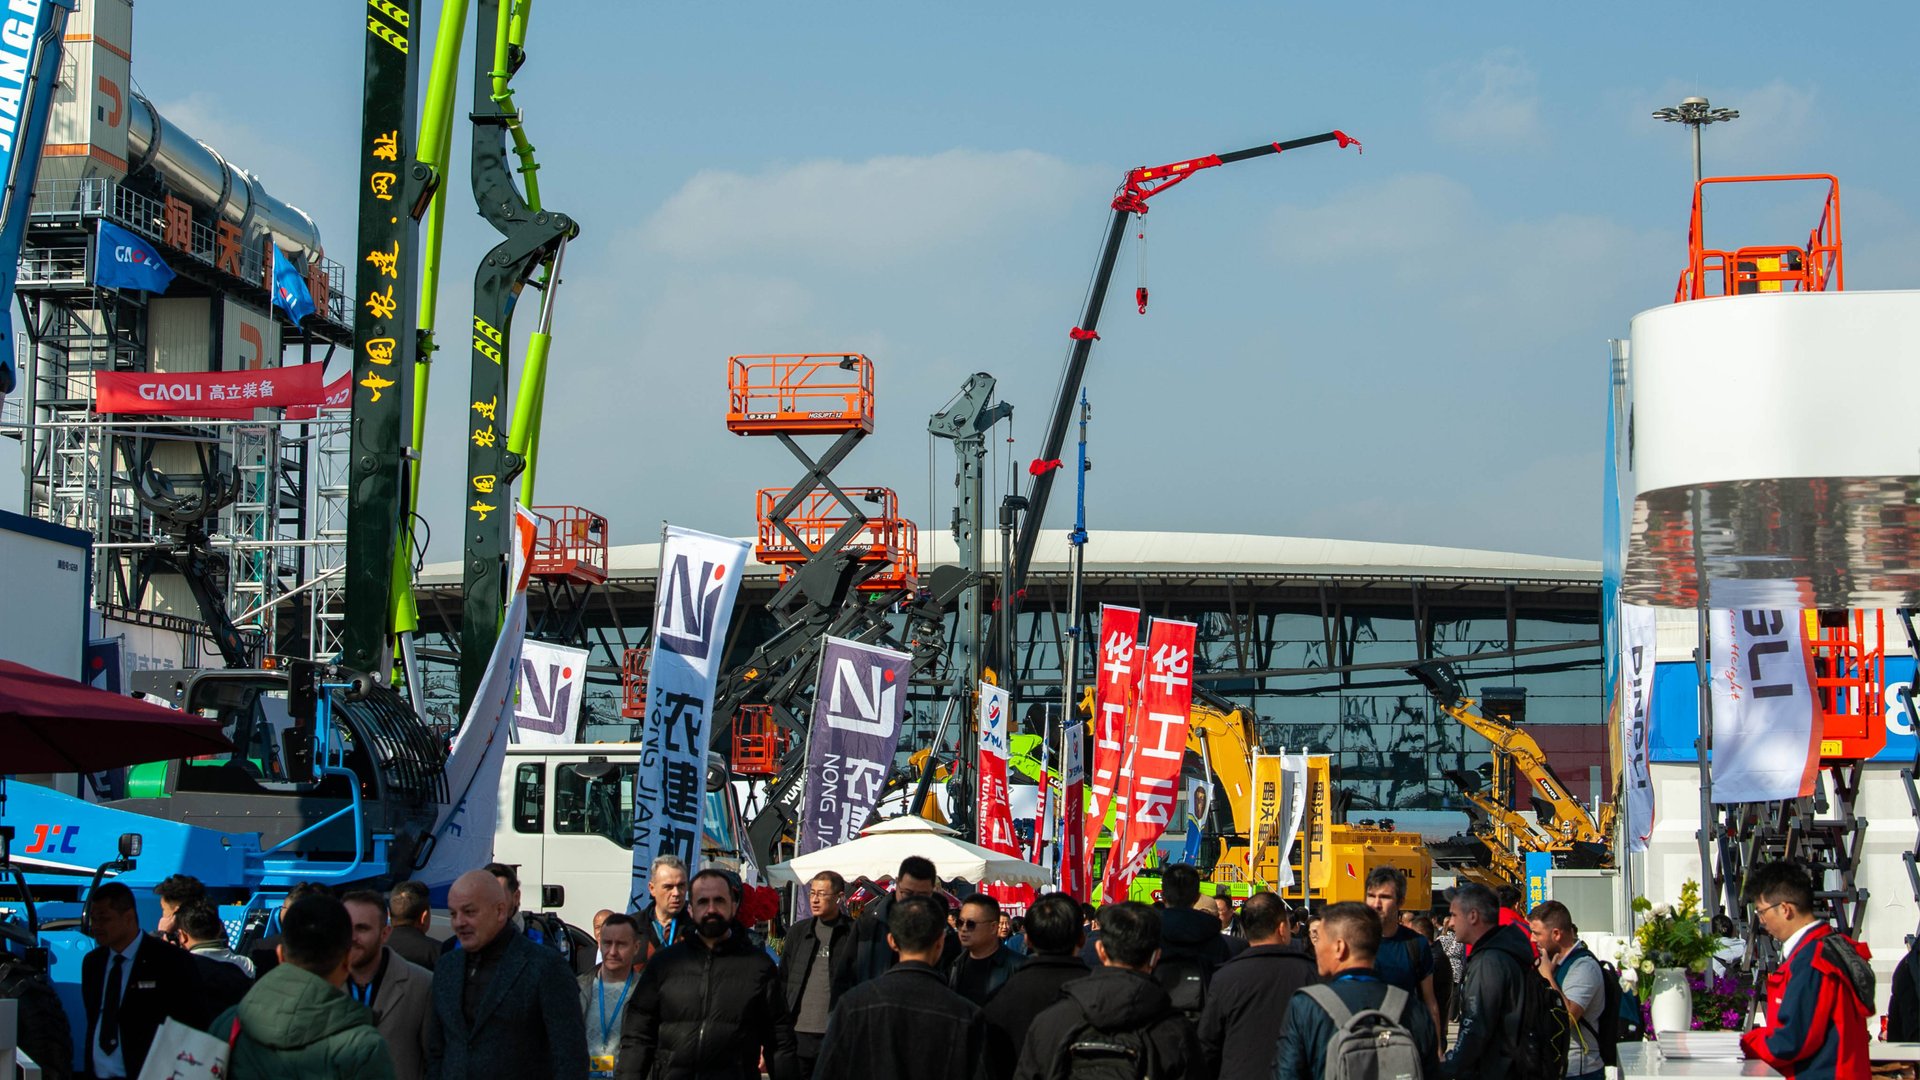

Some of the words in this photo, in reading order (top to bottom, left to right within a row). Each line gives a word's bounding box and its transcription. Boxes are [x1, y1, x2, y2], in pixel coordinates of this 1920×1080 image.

[139, 384, 201, 400] GAOLI
[210, 380, 275, 401] 高立装备
[1724, 643, 1743, 701] Height
[1632, 645, 1647, 789] DINGLI
[781, 773, 808, 806] YUAN
[819, 753, 841, 813] NONG
[979, 775, 992, 845] YUANSHAN
[1540, 779, 1560, 801] LOVOL
[633, 781, 658, 848] JIAN
[817, 818, 834, 850] JIA
[1257, 782, 1275, 851] 雷沃重
